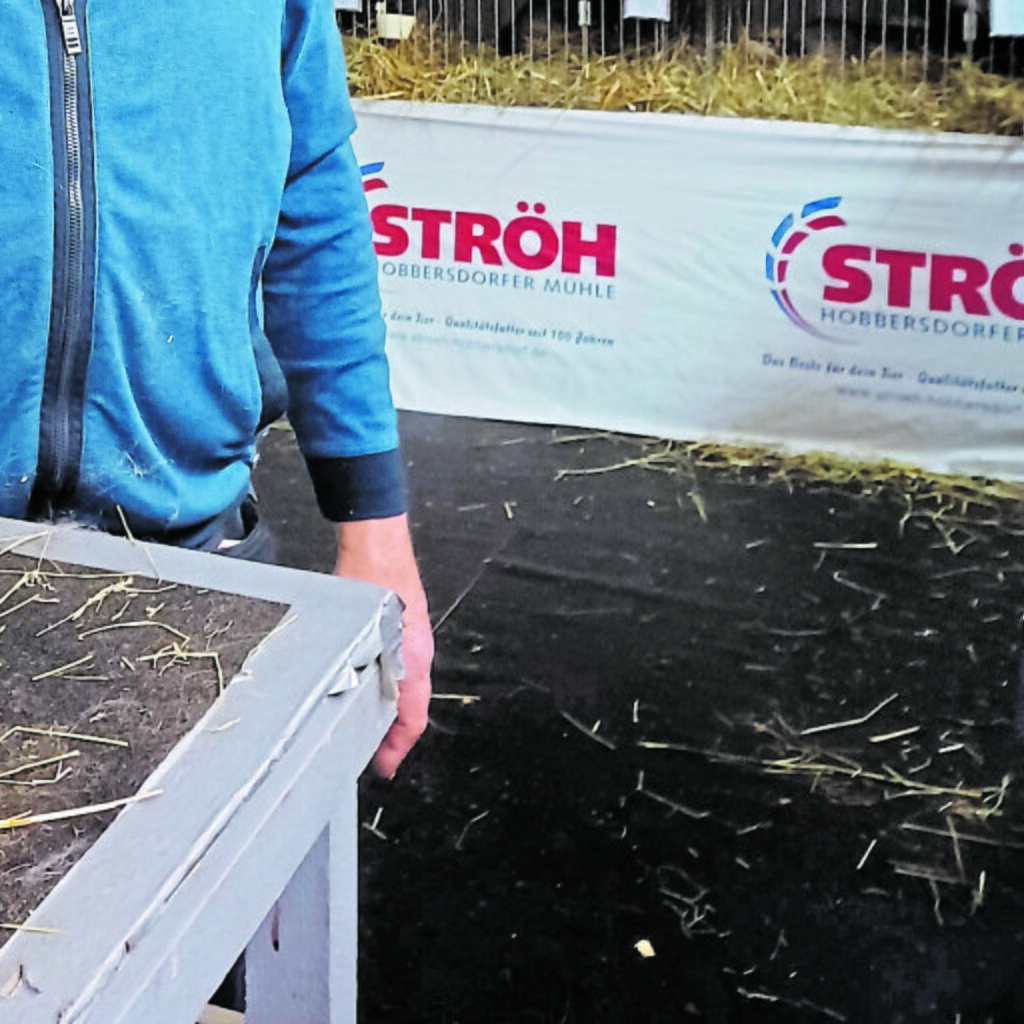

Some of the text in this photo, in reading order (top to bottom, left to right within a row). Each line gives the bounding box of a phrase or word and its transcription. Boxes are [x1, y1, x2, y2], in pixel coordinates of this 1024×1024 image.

[370, 201, 617, 278] STRÖH
[379, 261, 535, 290] OBBERSDORFER
[822, 243, 1024, 321] STRÖ
[551, 329, 572, 343] 100
